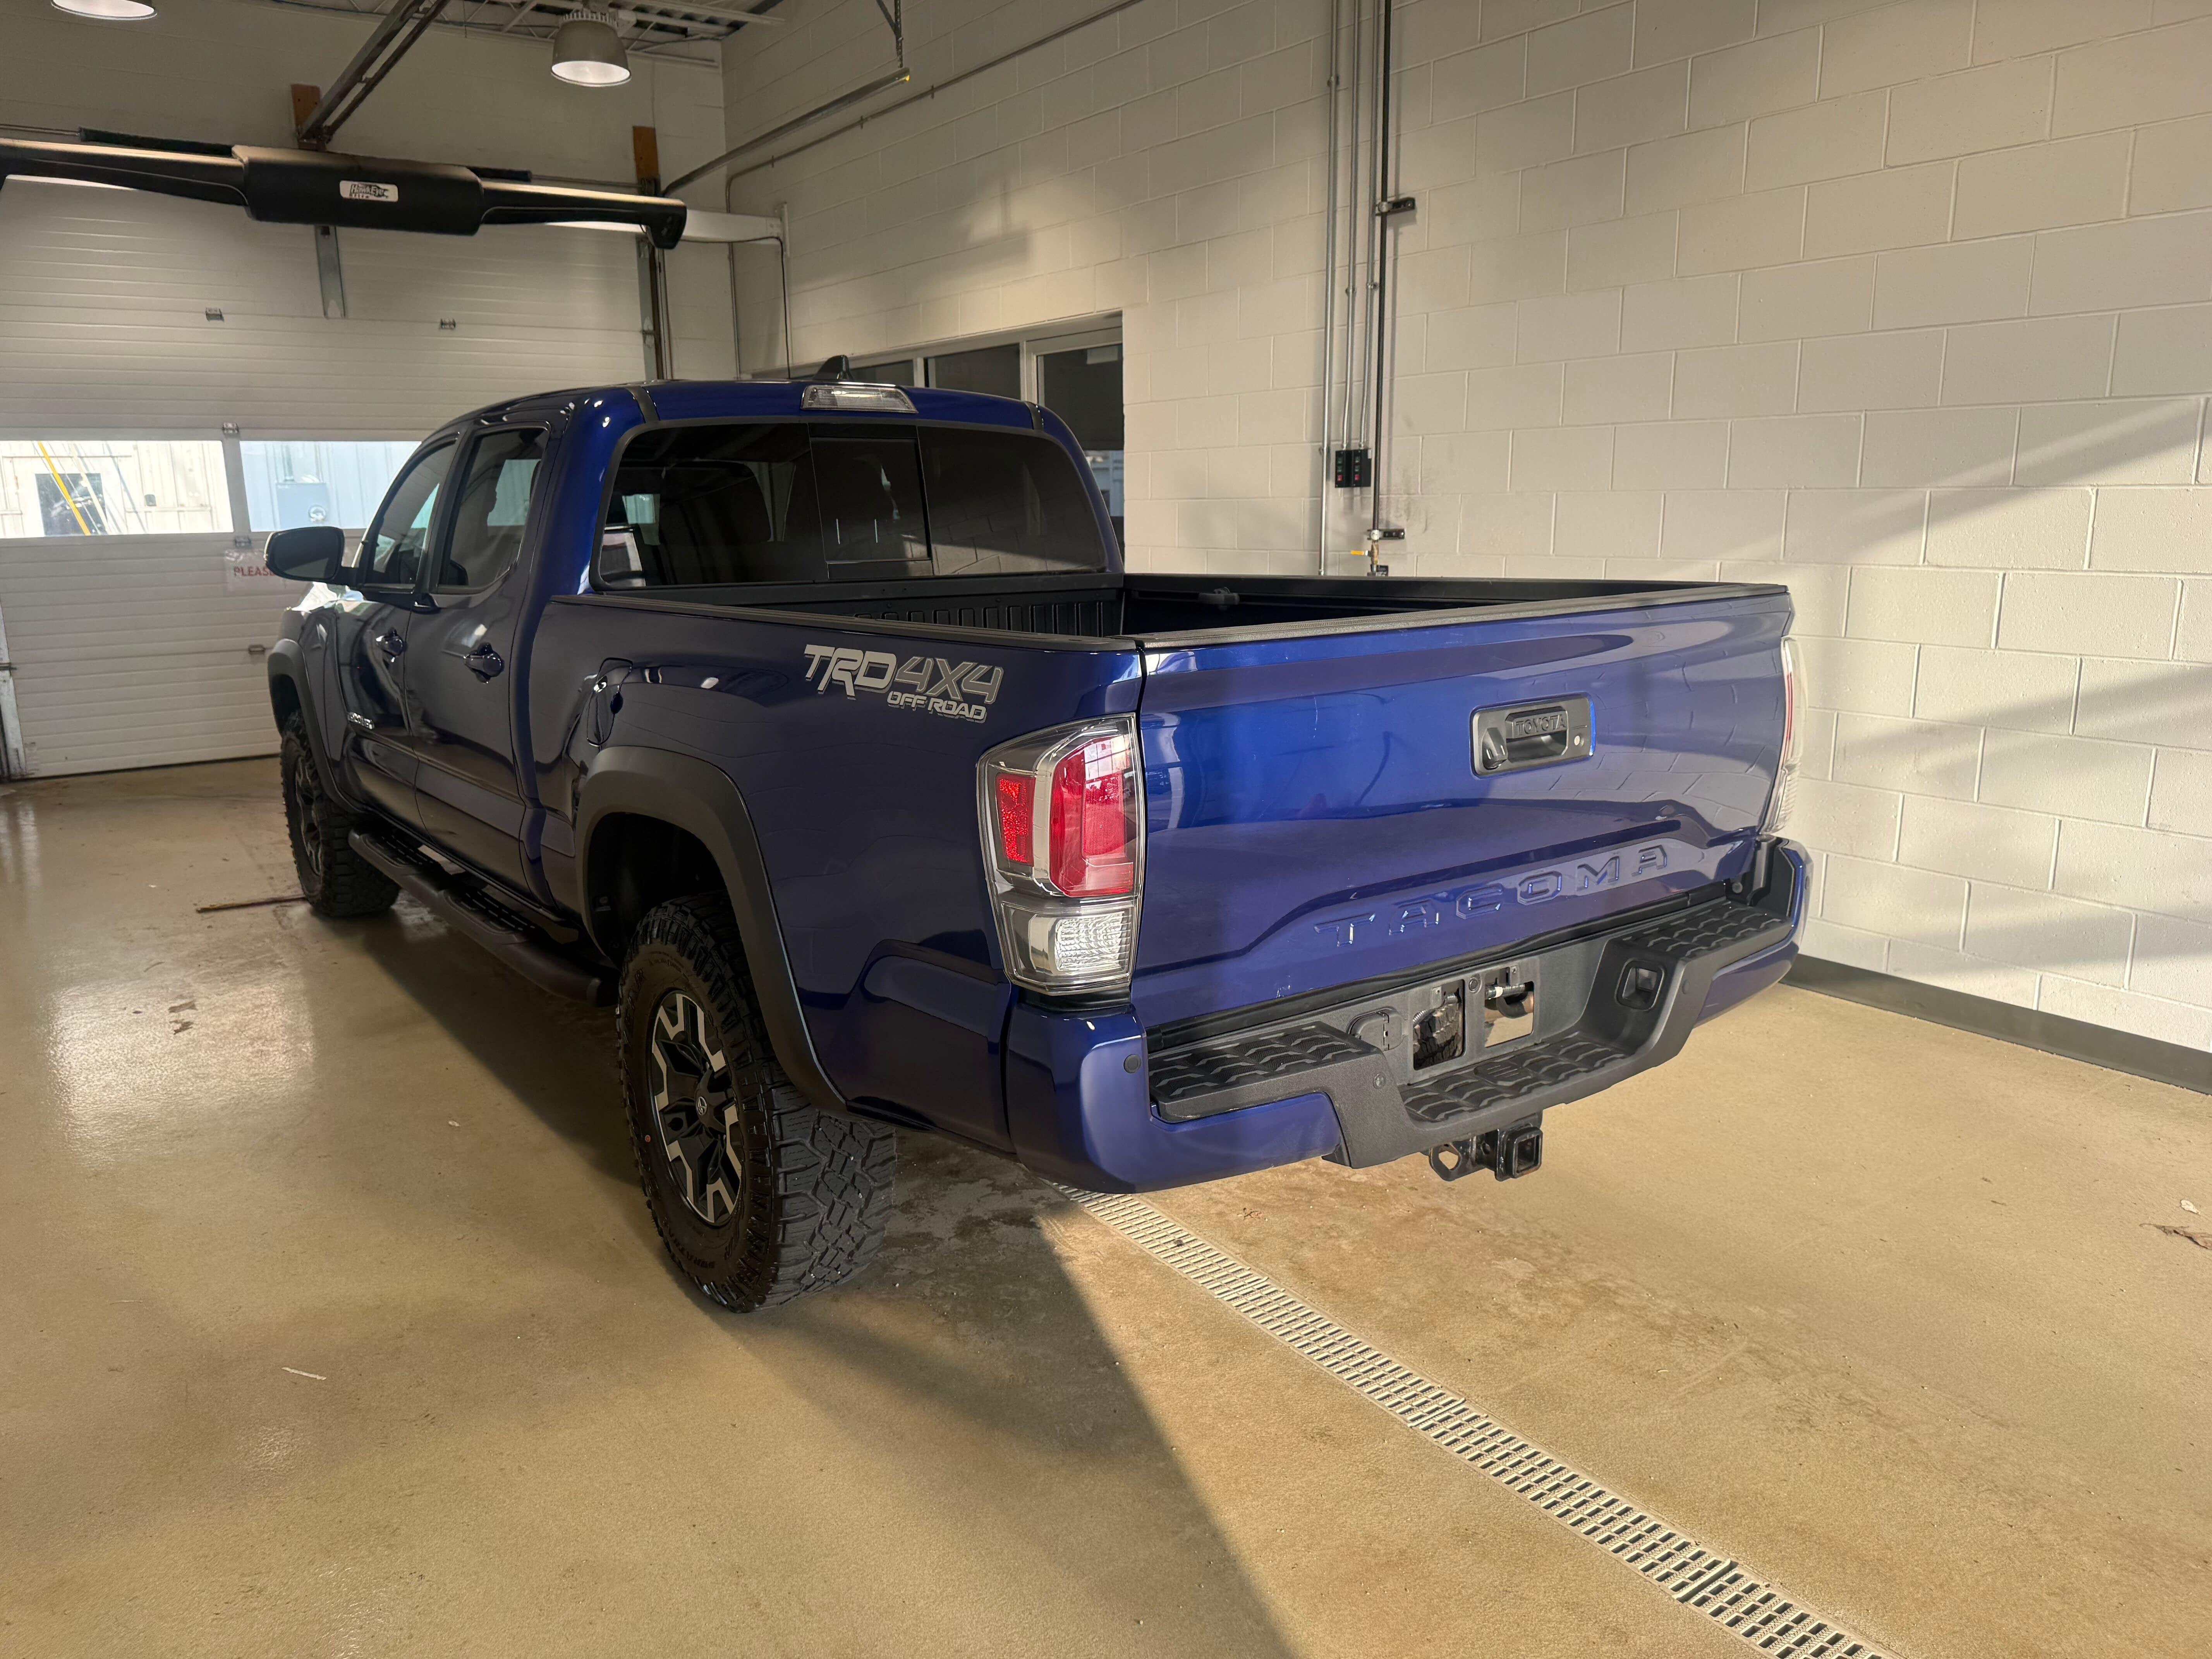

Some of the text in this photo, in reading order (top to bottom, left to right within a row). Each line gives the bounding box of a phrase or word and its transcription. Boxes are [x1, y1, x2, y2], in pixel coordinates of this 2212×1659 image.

[804, 644, 897, 697] TRD
[887, 691, 987, 720] OFF ROAD
[1515, 714, 1566, 736] TOYOTA
[1314, 845, 1668, 947] TACOMA
